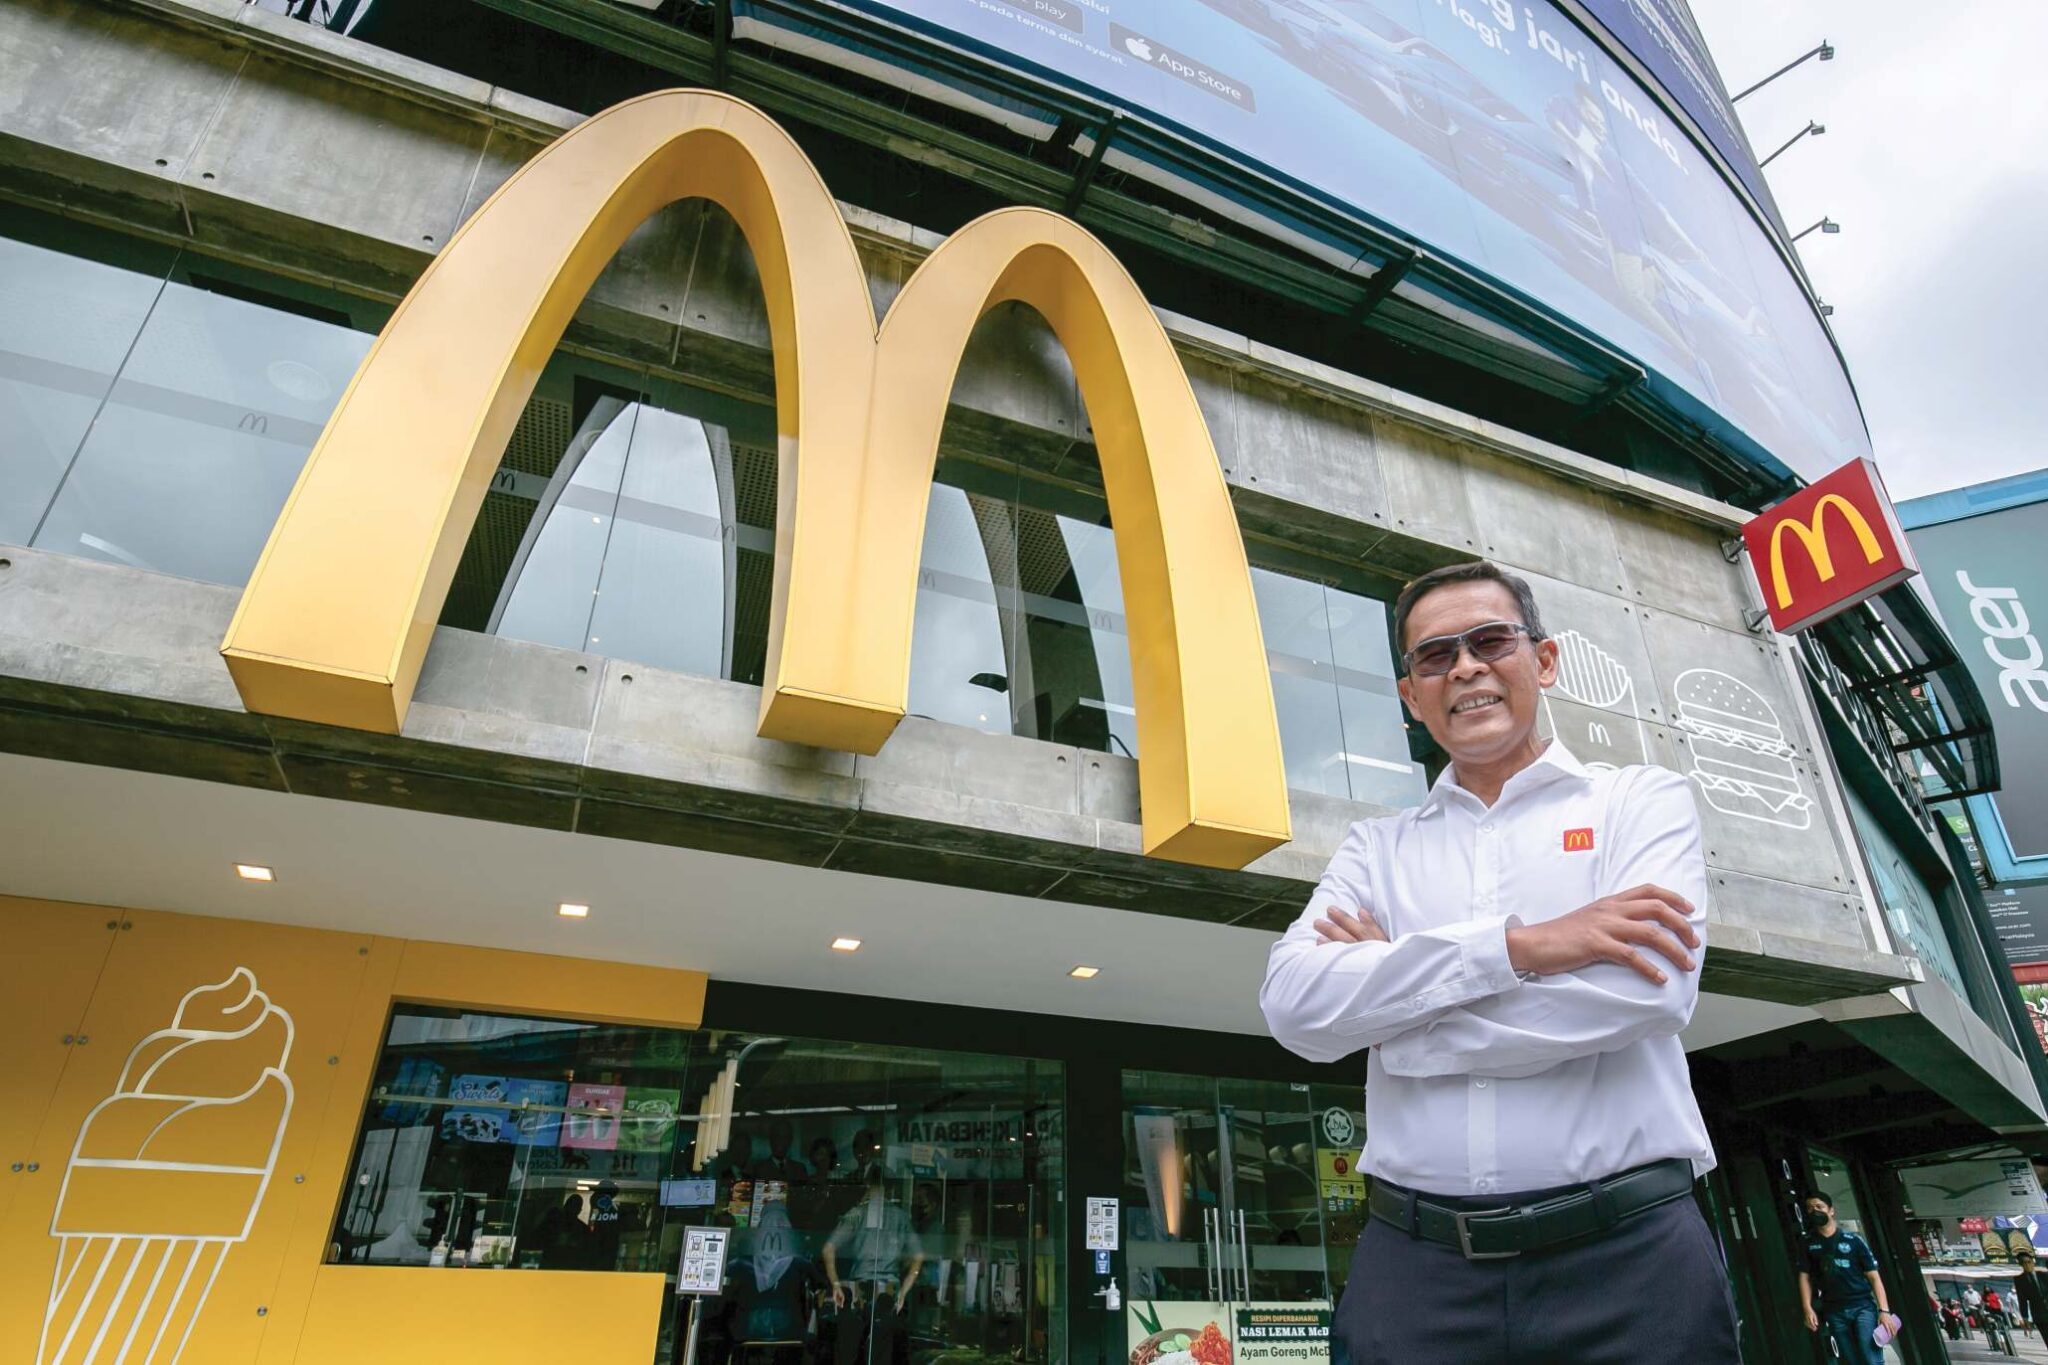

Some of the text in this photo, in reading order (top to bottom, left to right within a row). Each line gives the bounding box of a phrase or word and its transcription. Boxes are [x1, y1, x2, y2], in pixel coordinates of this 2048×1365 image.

[1058, 33, 1083, 48] dan
[1523, 7, 1590, 84] jari
[1159, 52, 1241, 100] App Store
[1956, 570, 2048, 713] acer
[1240, 1326, 1267, 1336] NASI
[1268, 1326, 1306, 1336] LEMAK
[1240, 1347, 1268, 1360] Ayam
[1270, 1346, 1307, 1359] Goreng
